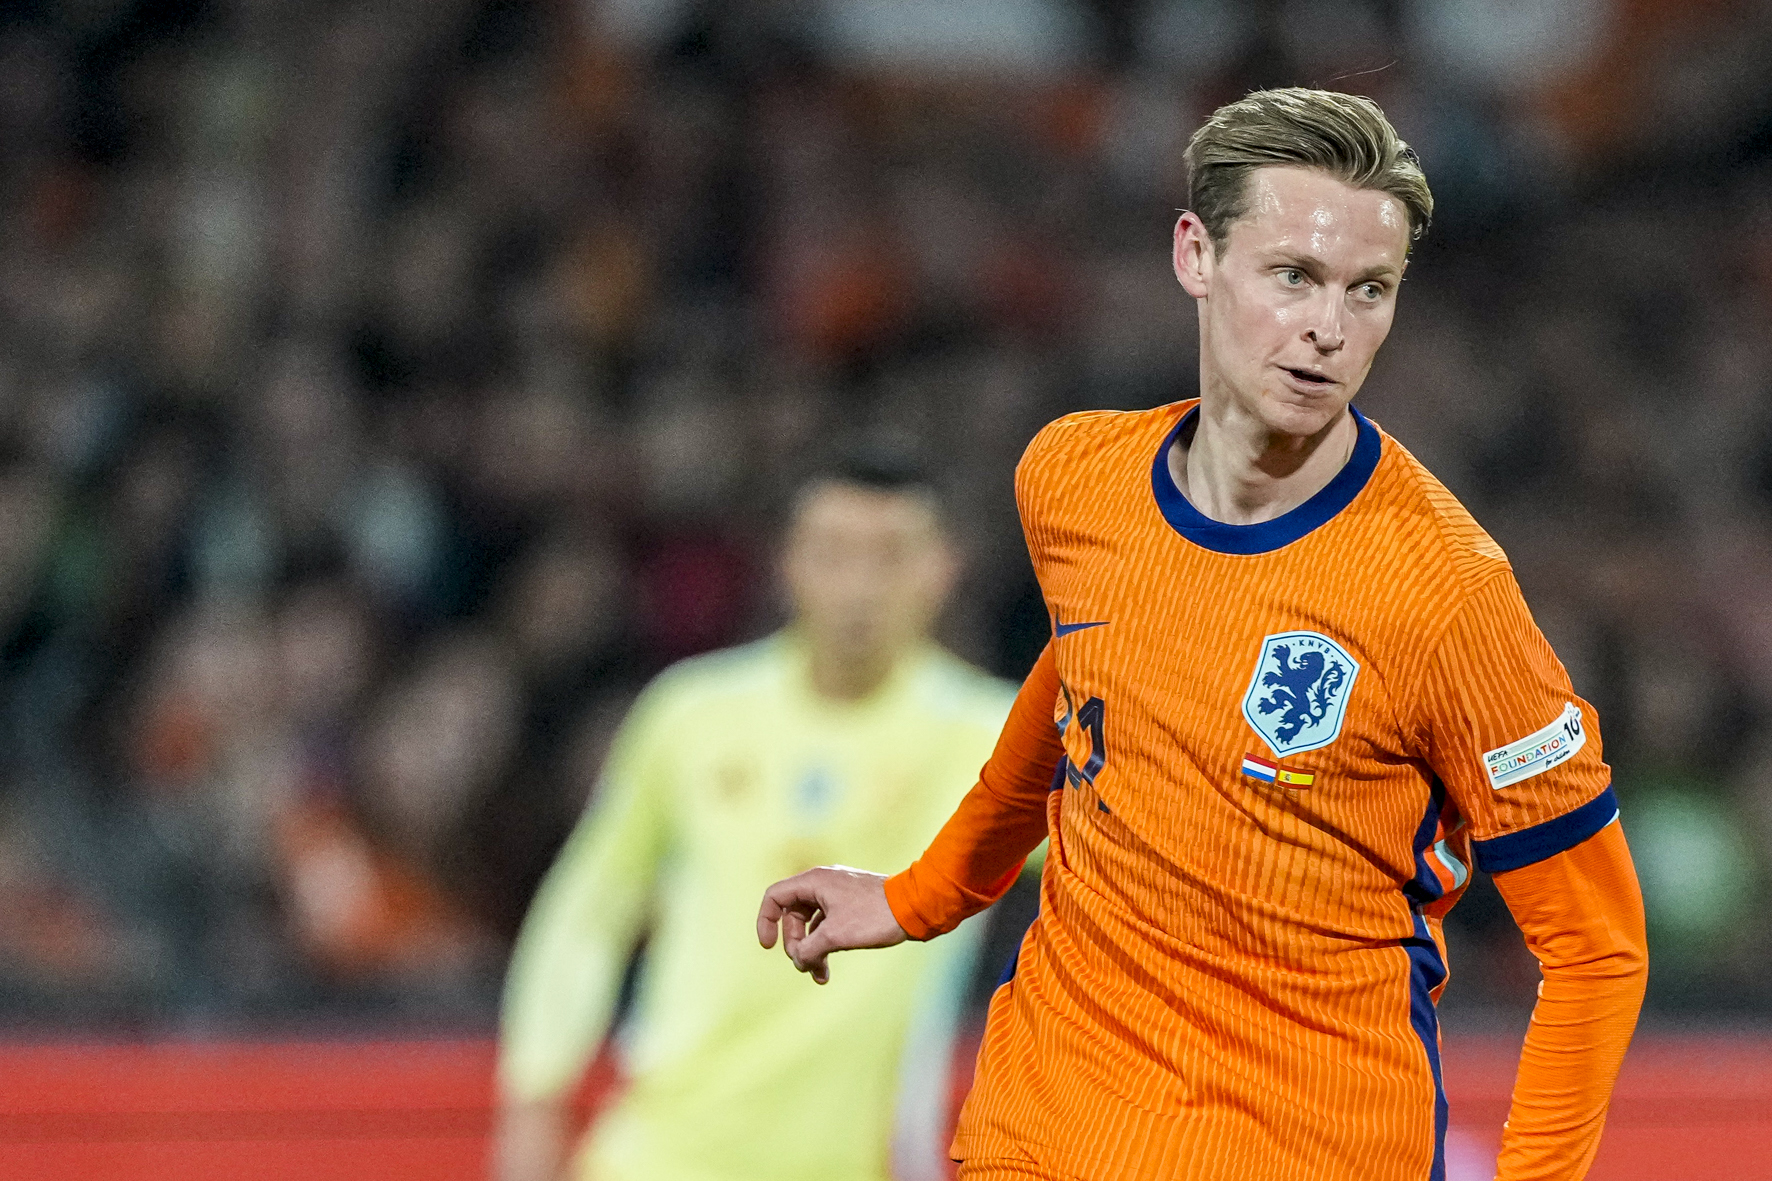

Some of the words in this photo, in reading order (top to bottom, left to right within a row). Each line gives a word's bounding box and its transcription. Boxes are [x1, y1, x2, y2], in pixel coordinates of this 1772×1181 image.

[1299, 639, 1331, 655] KNVB
[1564, 717, 1580, 741] 10
[1487, 750, 1508, 763] UEFA
[1490, 735, 1567, 776] FOUNDATION
